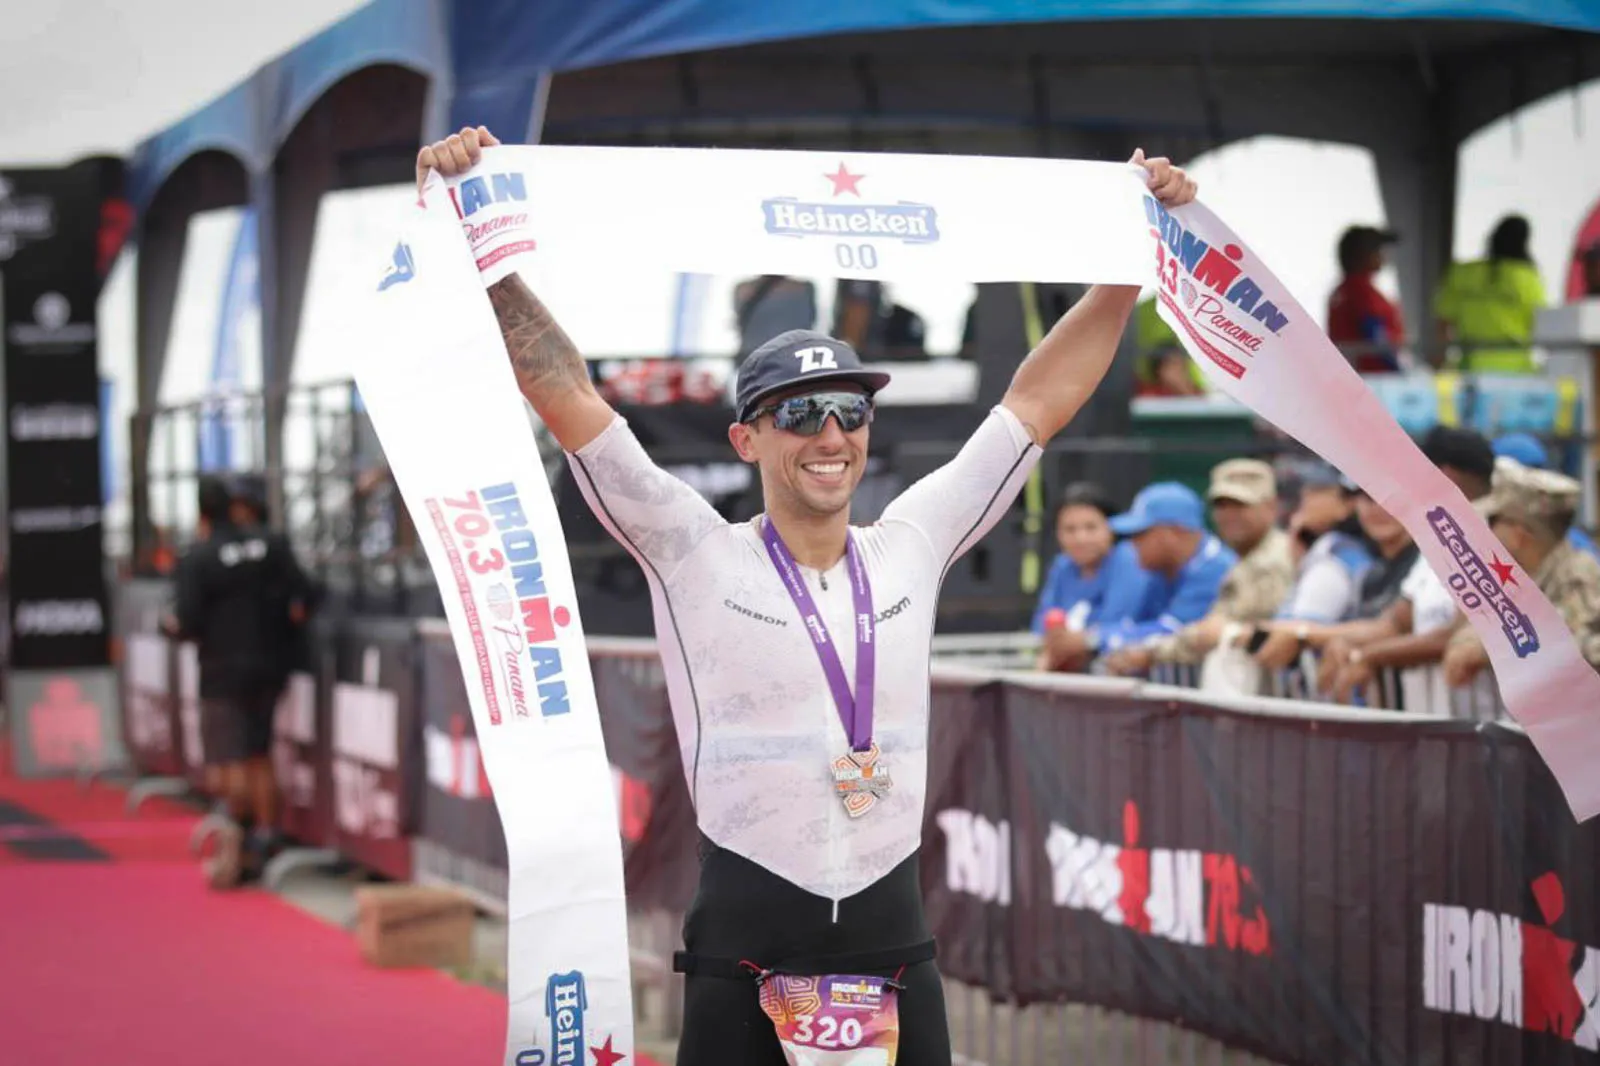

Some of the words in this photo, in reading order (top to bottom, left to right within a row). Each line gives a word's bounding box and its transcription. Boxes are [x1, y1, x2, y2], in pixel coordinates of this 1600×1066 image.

[449, 173, 527, 219] AN
[771, 203, 930, 236] Heineken
[835, 243, 878, 270] 0.0
[444, 490, 504, 575] 70.3
[480, 482, 571, 718] IRONMAN
[1433, 514, 1530, 649] Heineken
[1448, 572, 1482, 609] 0.0
[724, 599, 787, 627] CARBON
[554, 981, 580, 1066] Hein
[793, 1014, 862, 1047] 320
